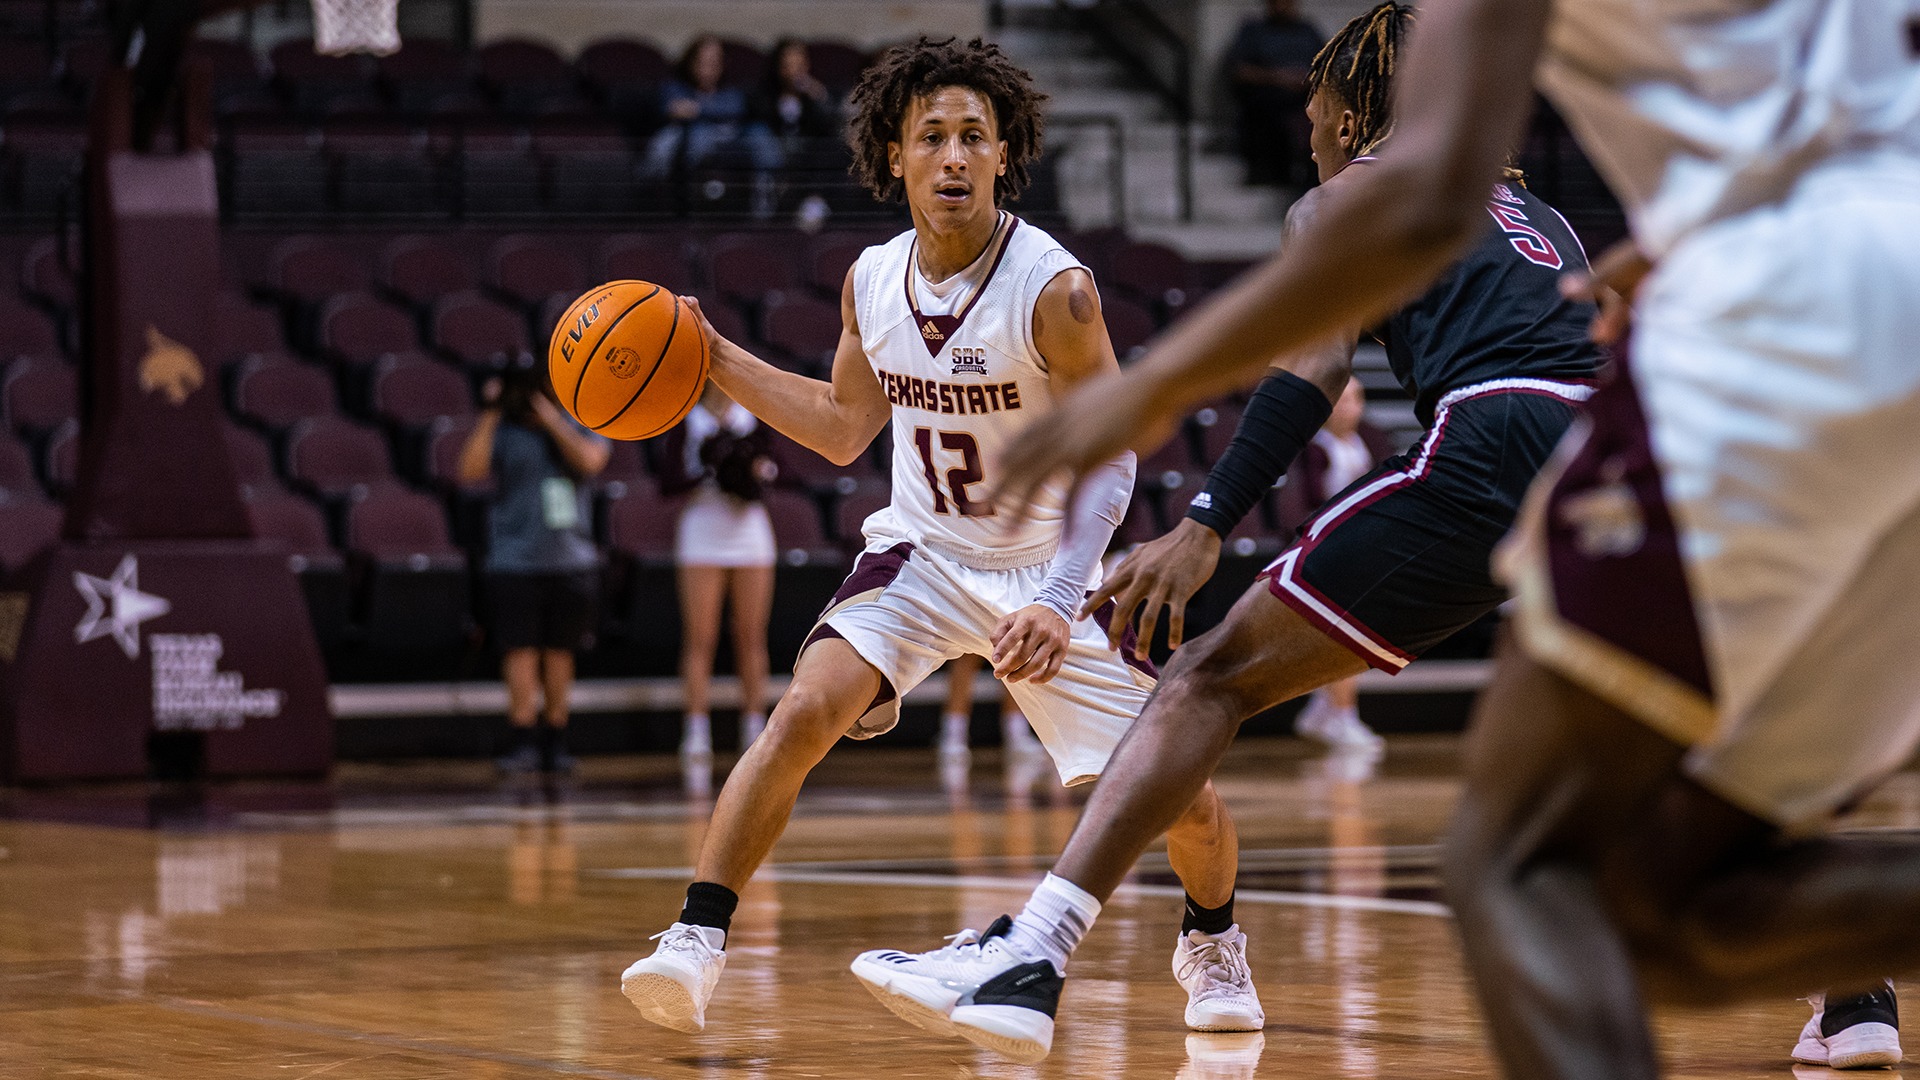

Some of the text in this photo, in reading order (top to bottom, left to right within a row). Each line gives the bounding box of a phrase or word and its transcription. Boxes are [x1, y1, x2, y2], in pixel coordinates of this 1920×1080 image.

[1486, 201, 1564, 270] 5
[561, 303, 600, 364] EVO
[951, 347, 986, 365] SBC
[914, 425, 998, 518] 12
[1015, 971, 1042, 986] MITCHELL
